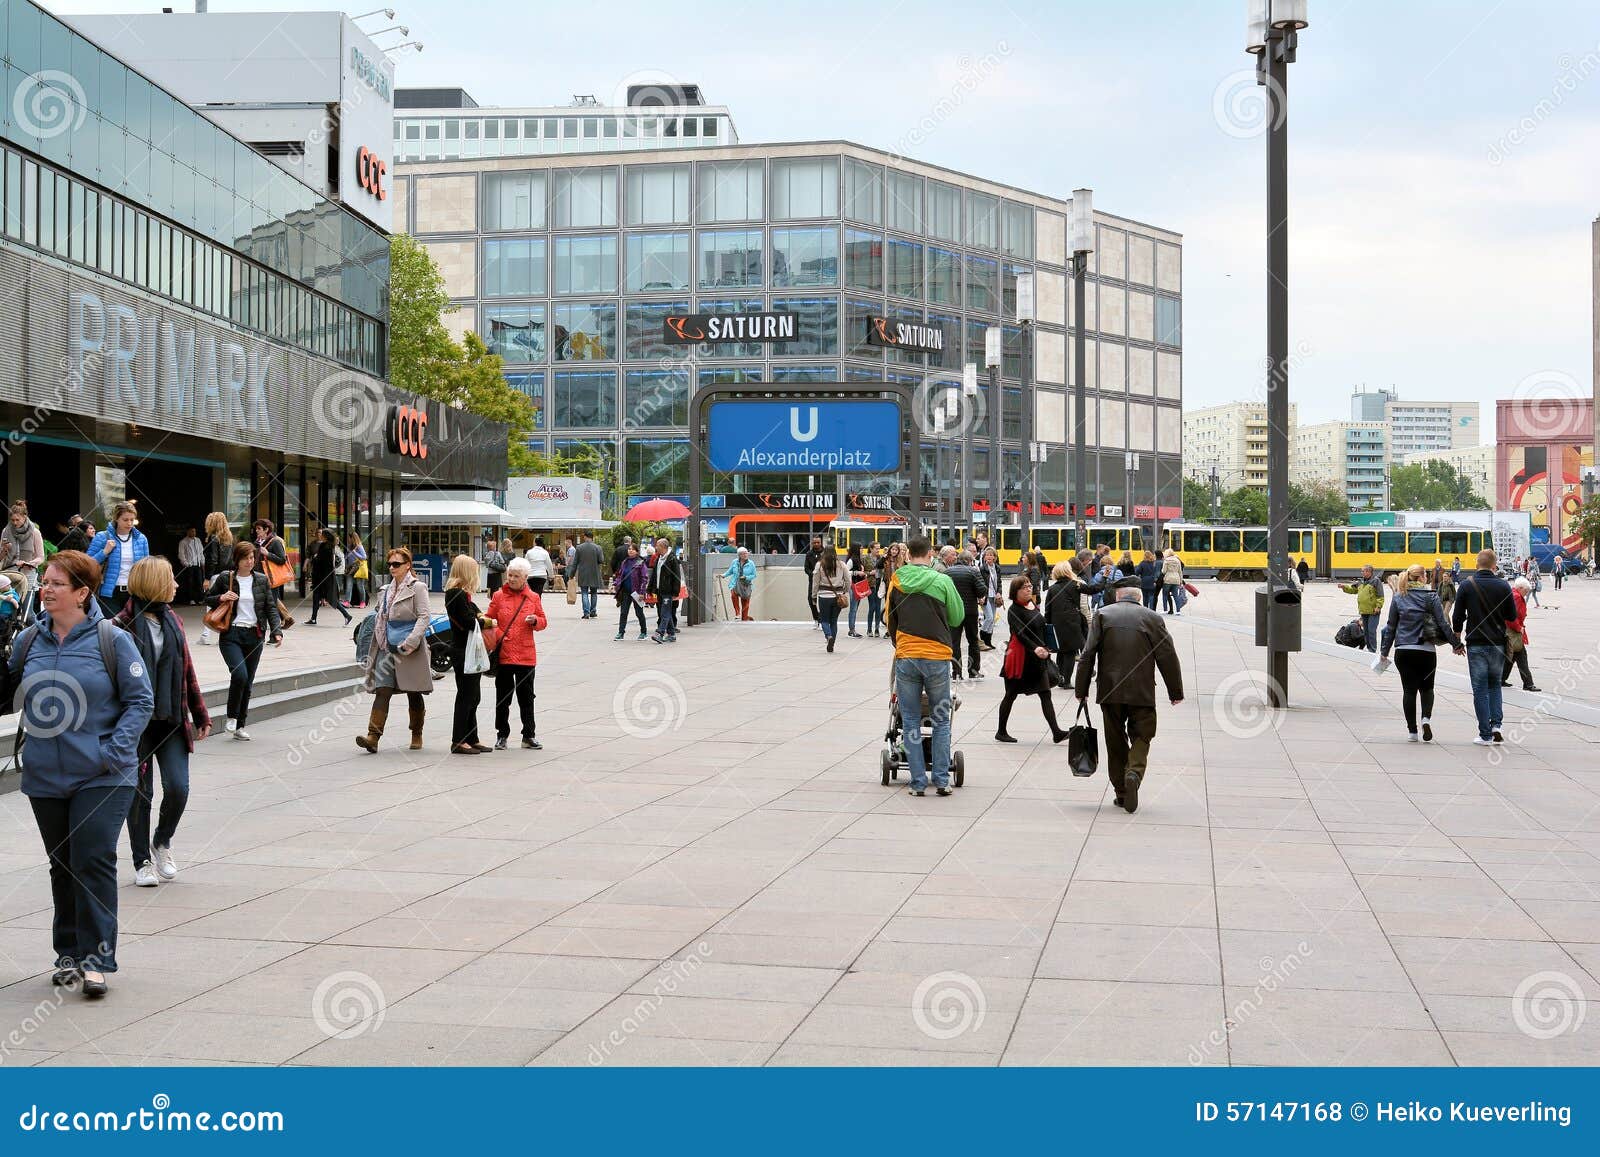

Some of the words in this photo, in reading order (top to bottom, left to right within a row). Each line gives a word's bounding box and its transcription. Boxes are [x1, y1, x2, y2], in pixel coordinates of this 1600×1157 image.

[359, 144, 386, 201] CCC
[708, 315, 794, 339] SATURN
[898, 323, 942, 350] SATURN
[70, 291, 272, 434] PRIMARK
[398, 405, 427, 459] CCC
[790, 407, 818, 442] U
[738, 448, 871, 470] Alexanderplatz
[783, 494, 833, 508] SATURN
